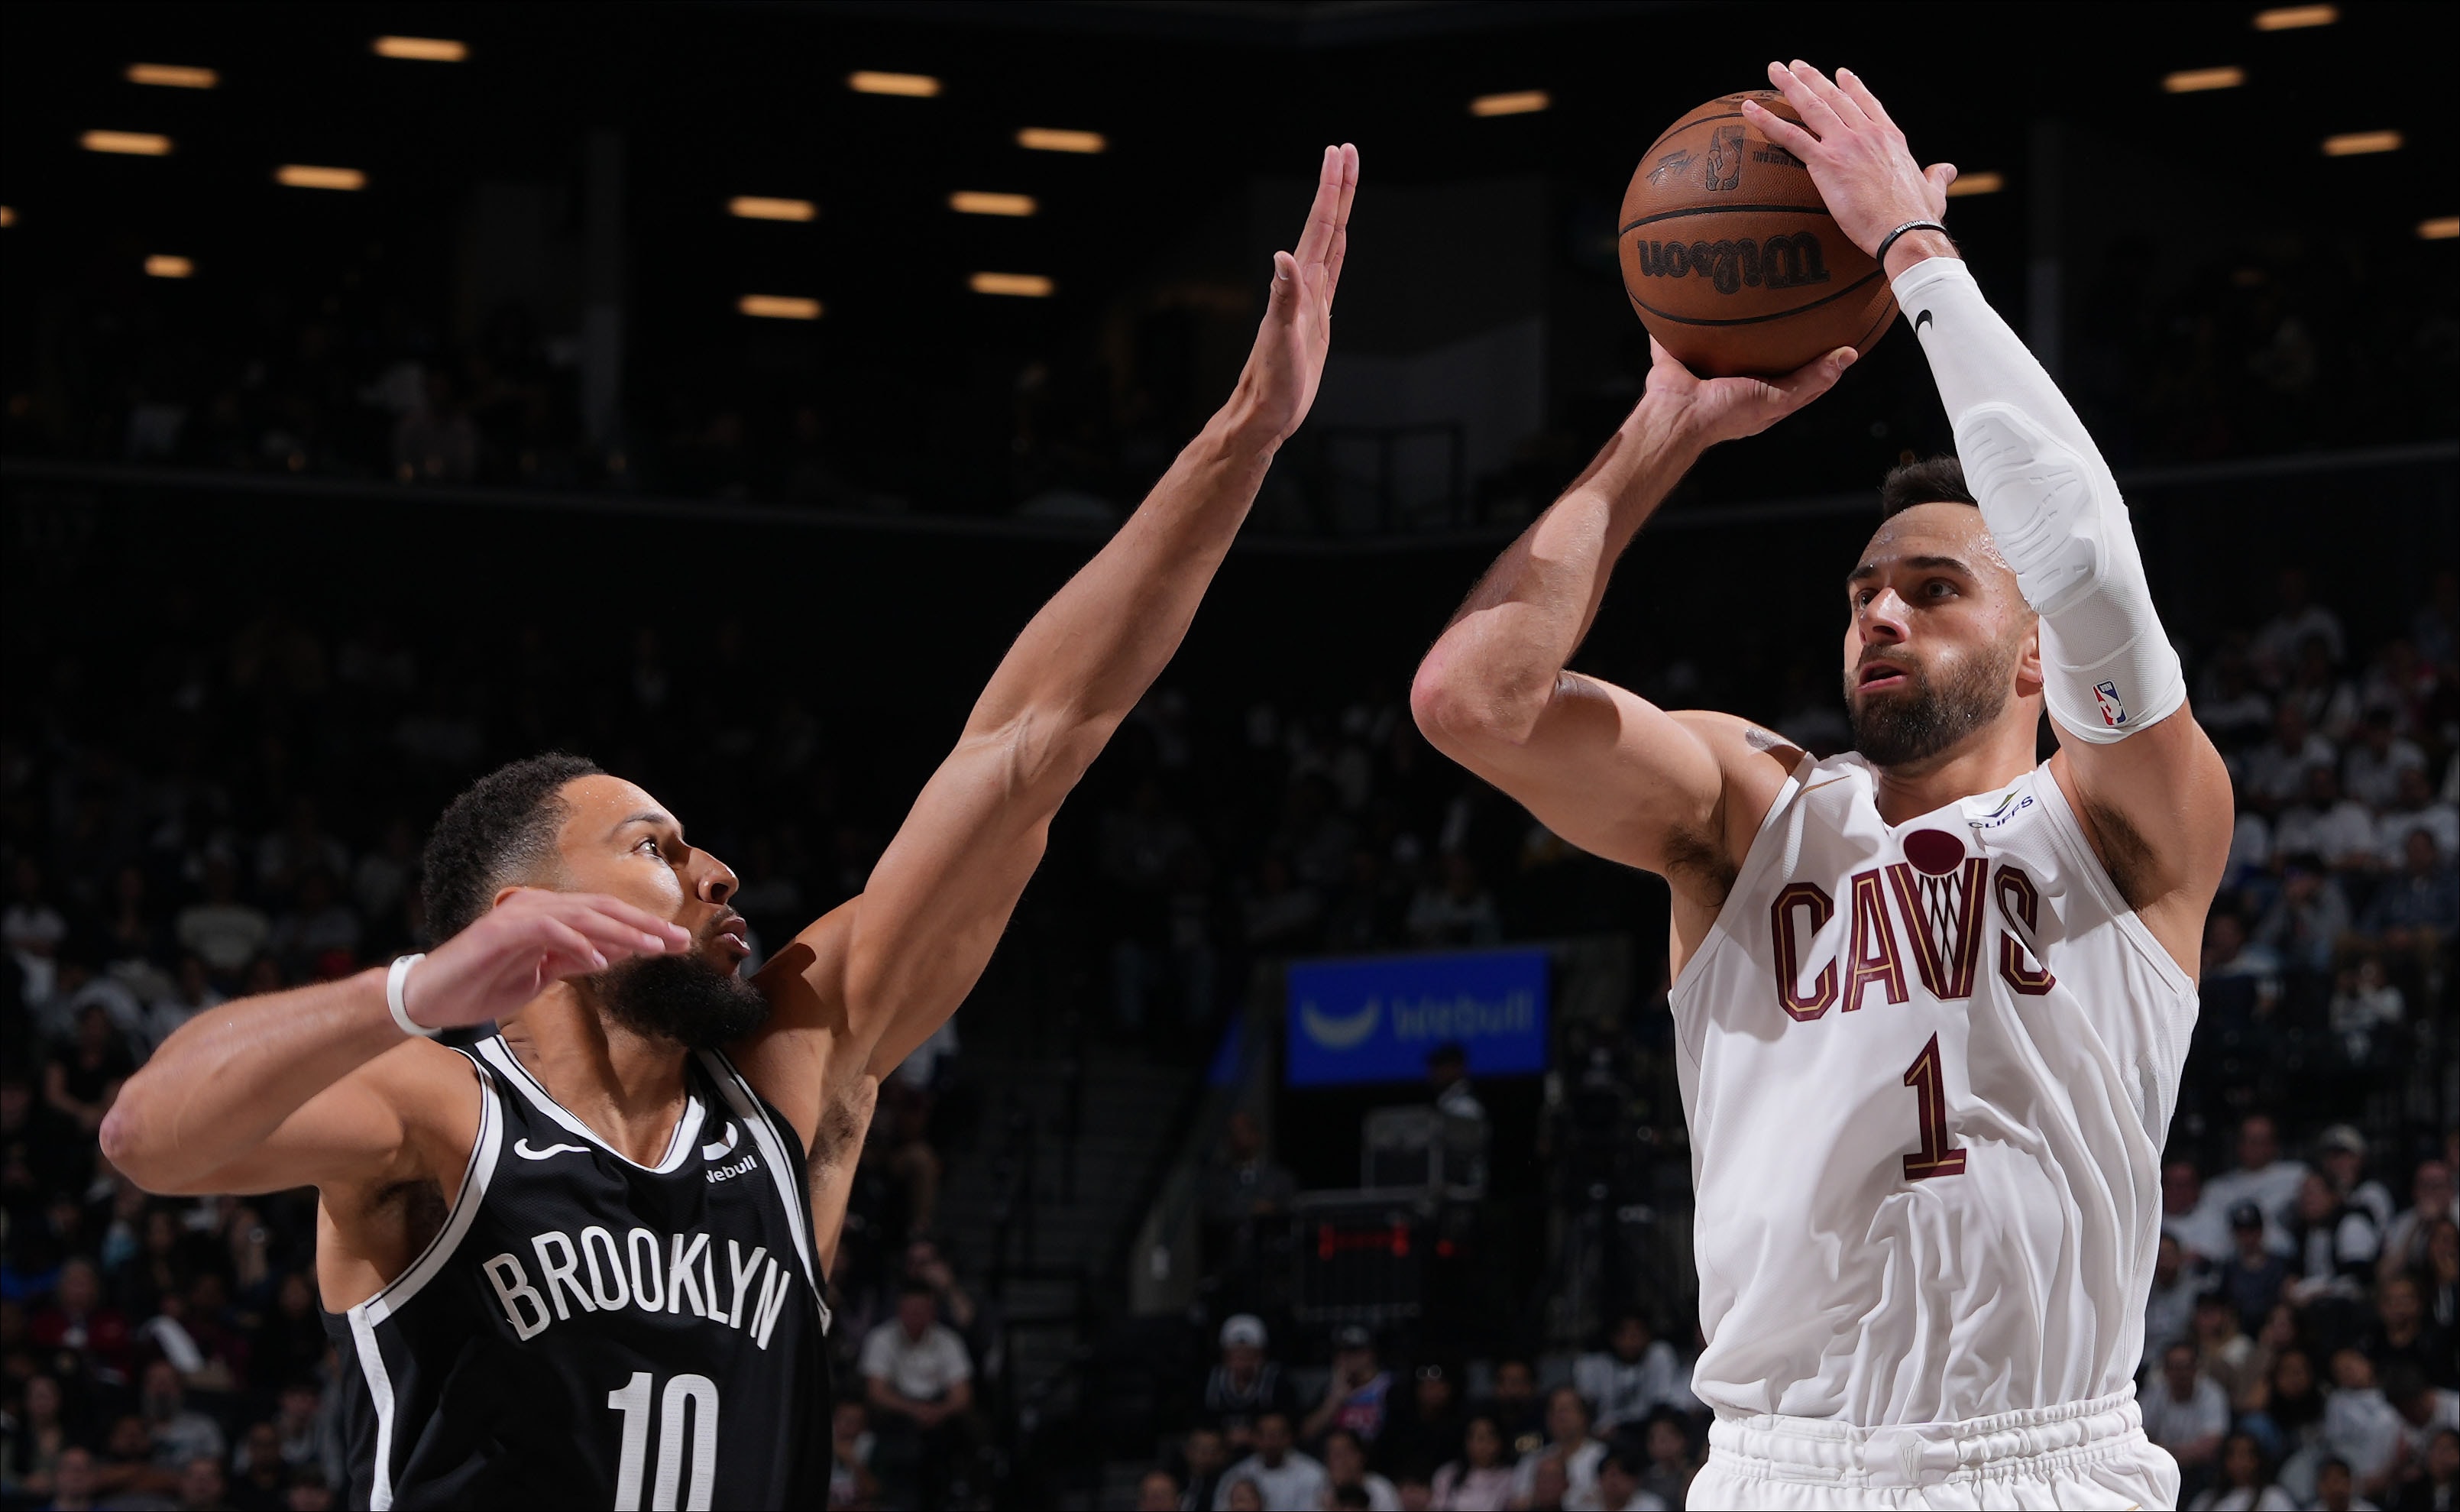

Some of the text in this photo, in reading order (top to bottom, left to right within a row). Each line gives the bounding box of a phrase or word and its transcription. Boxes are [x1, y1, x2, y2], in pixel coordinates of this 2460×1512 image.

[1637, 231, 1830, 295] Wilson
[1968, 795, 2034, 829] CLIFFS
[1770, 856, 2057, 1022] CAVS
[1903, 1031, 1966, 1181] 1
[482, 1225, 791, 1350] BROOKLYN
[608, 1371, 719, 1511] 10
